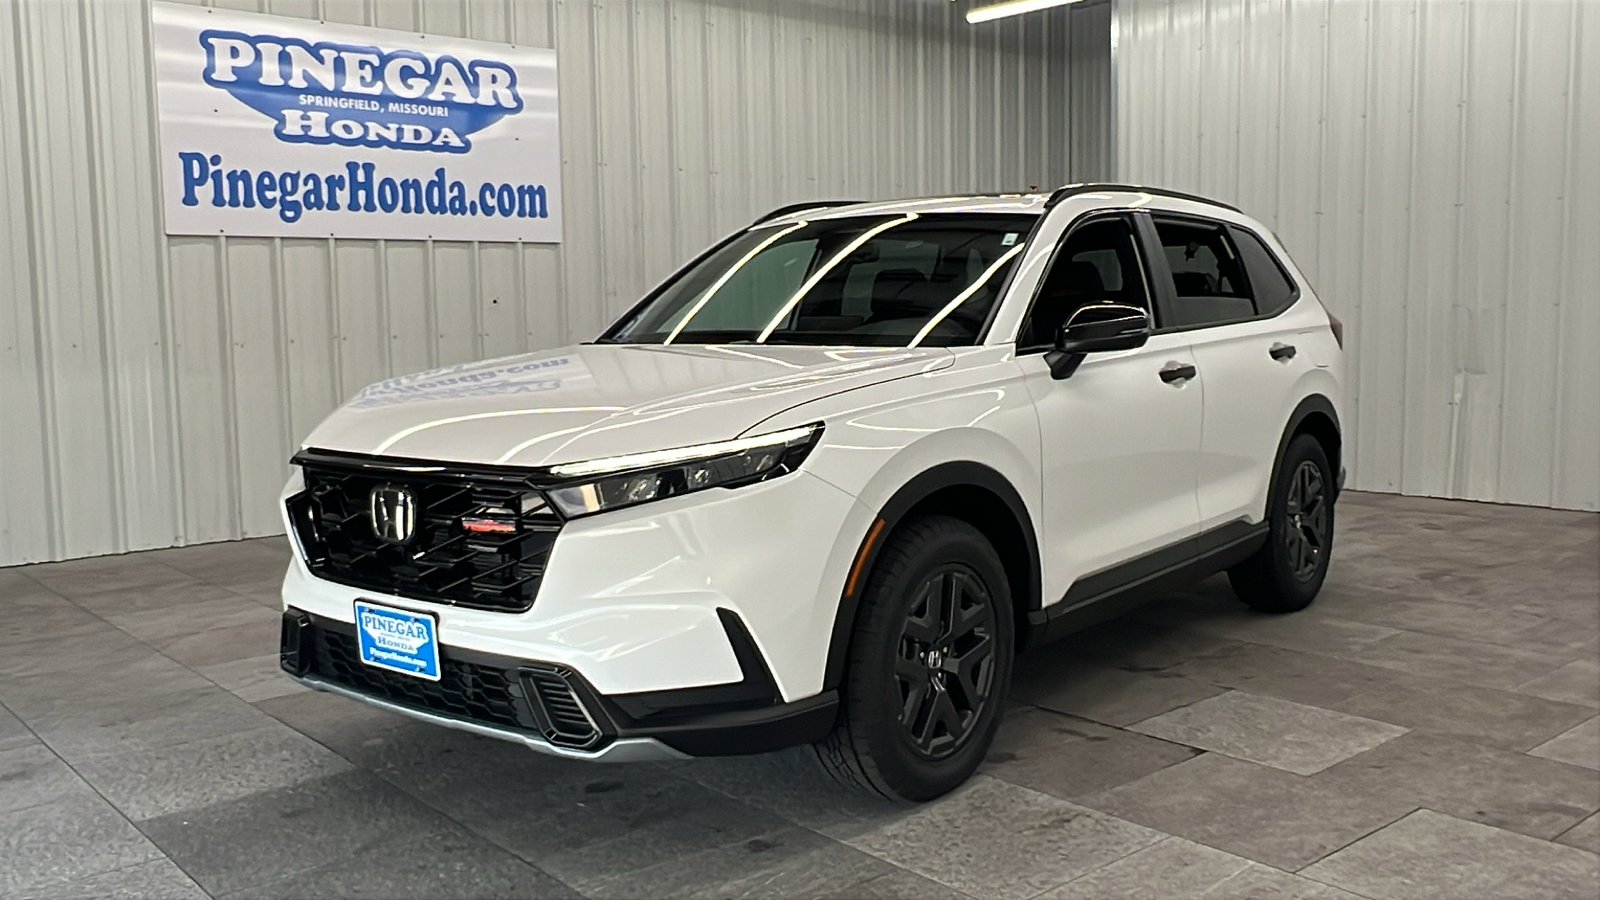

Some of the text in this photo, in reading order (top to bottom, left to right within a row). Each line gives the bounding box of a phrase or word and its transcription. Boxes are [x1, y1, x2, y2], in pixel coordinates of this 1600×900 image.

[206, 37, 518, 109] PINEGAR
[299, 93, 449, 117] SPRINGFIELD, MISSOURI
[280, 109, 466, 147] HONDA
[178, 151, 549, 223] PinegarHonda.com
[363, 615, 427, 640] PINEGAR
[377, 636, 415, 652] HONDA
